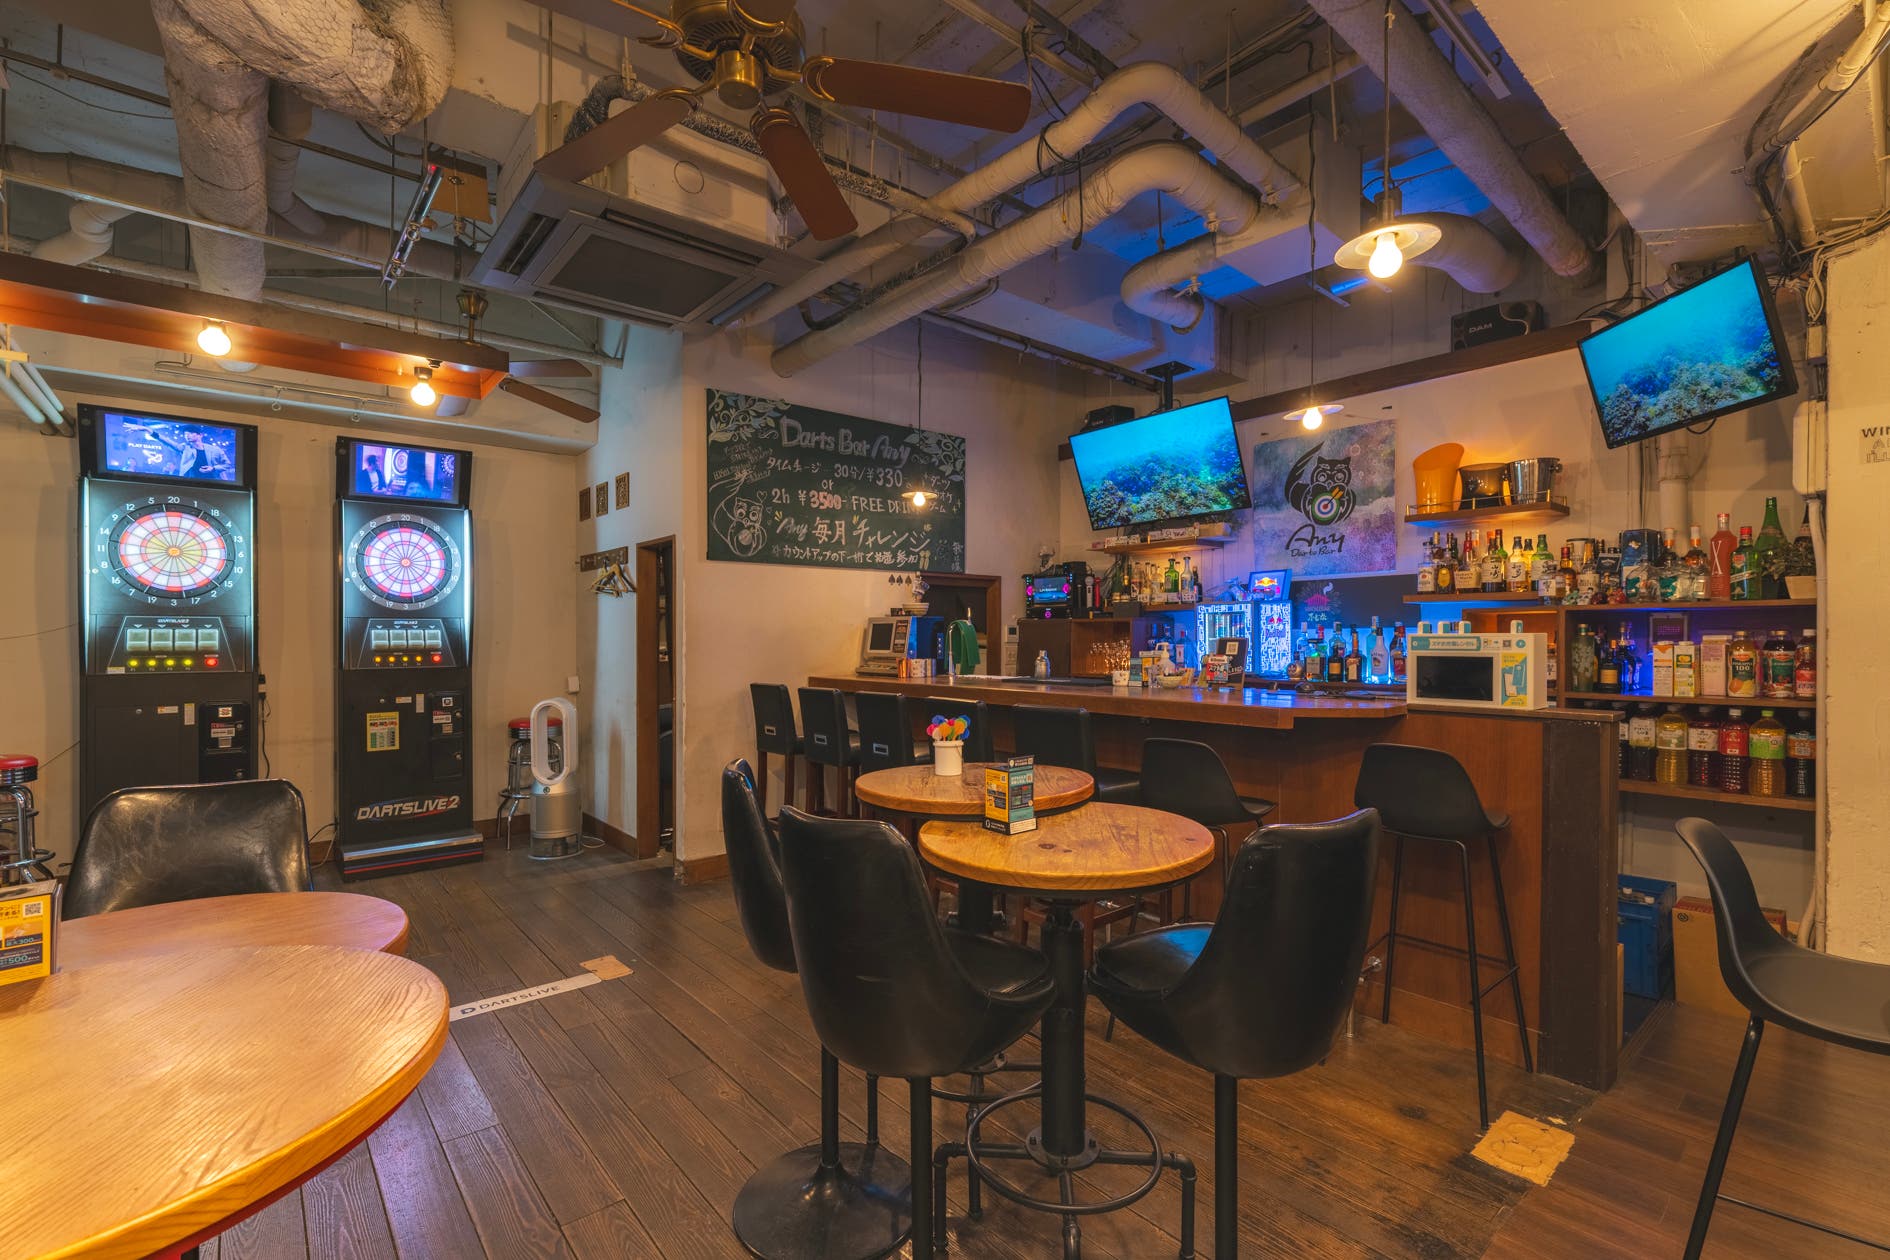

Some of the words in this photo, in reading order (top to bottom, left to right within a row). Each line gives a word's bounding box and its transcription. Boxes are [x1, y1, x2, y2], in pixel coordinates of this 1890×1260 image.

[1468, 323, 1493, 334] DAM
[780, 417, 836, 451] Darts
[838, 427, 871, 458] Bar
[871, 434, 912, 469] Any
[822, 479, 834, 490] or
[168, 496, 180, 504] 20
[771, 488, 790, 504] 2h
[852, 495, 885, 513] FREE
[126, 503, 135, 511] 12
[211, 509, 219, 517] 18
[776, 516, 809, 542] Any
[812, 516, 846, 546] 毎月
[852, 518, 931, 552] チャレンジ
[1285, 523, 1346, 553] Any
[233, 535, 243, 543] 13
[97, 544, 105, 552] 11
[1318, 545, 1337, 556] Bar
[101, 561, 108, 569] 8
[233, 566, 243, 574] 10
[111, 577, 120, 585] 16
[224, 580, 233, 588] 15
[129, 588, 135, 596] 7
[211, 590, 217, 598] 2
[147, 596, 158, 604] 19
[356, 795, 461, 821] DARTSLIVE2
[479, 985, 561, 1010] DARTSLIVE
